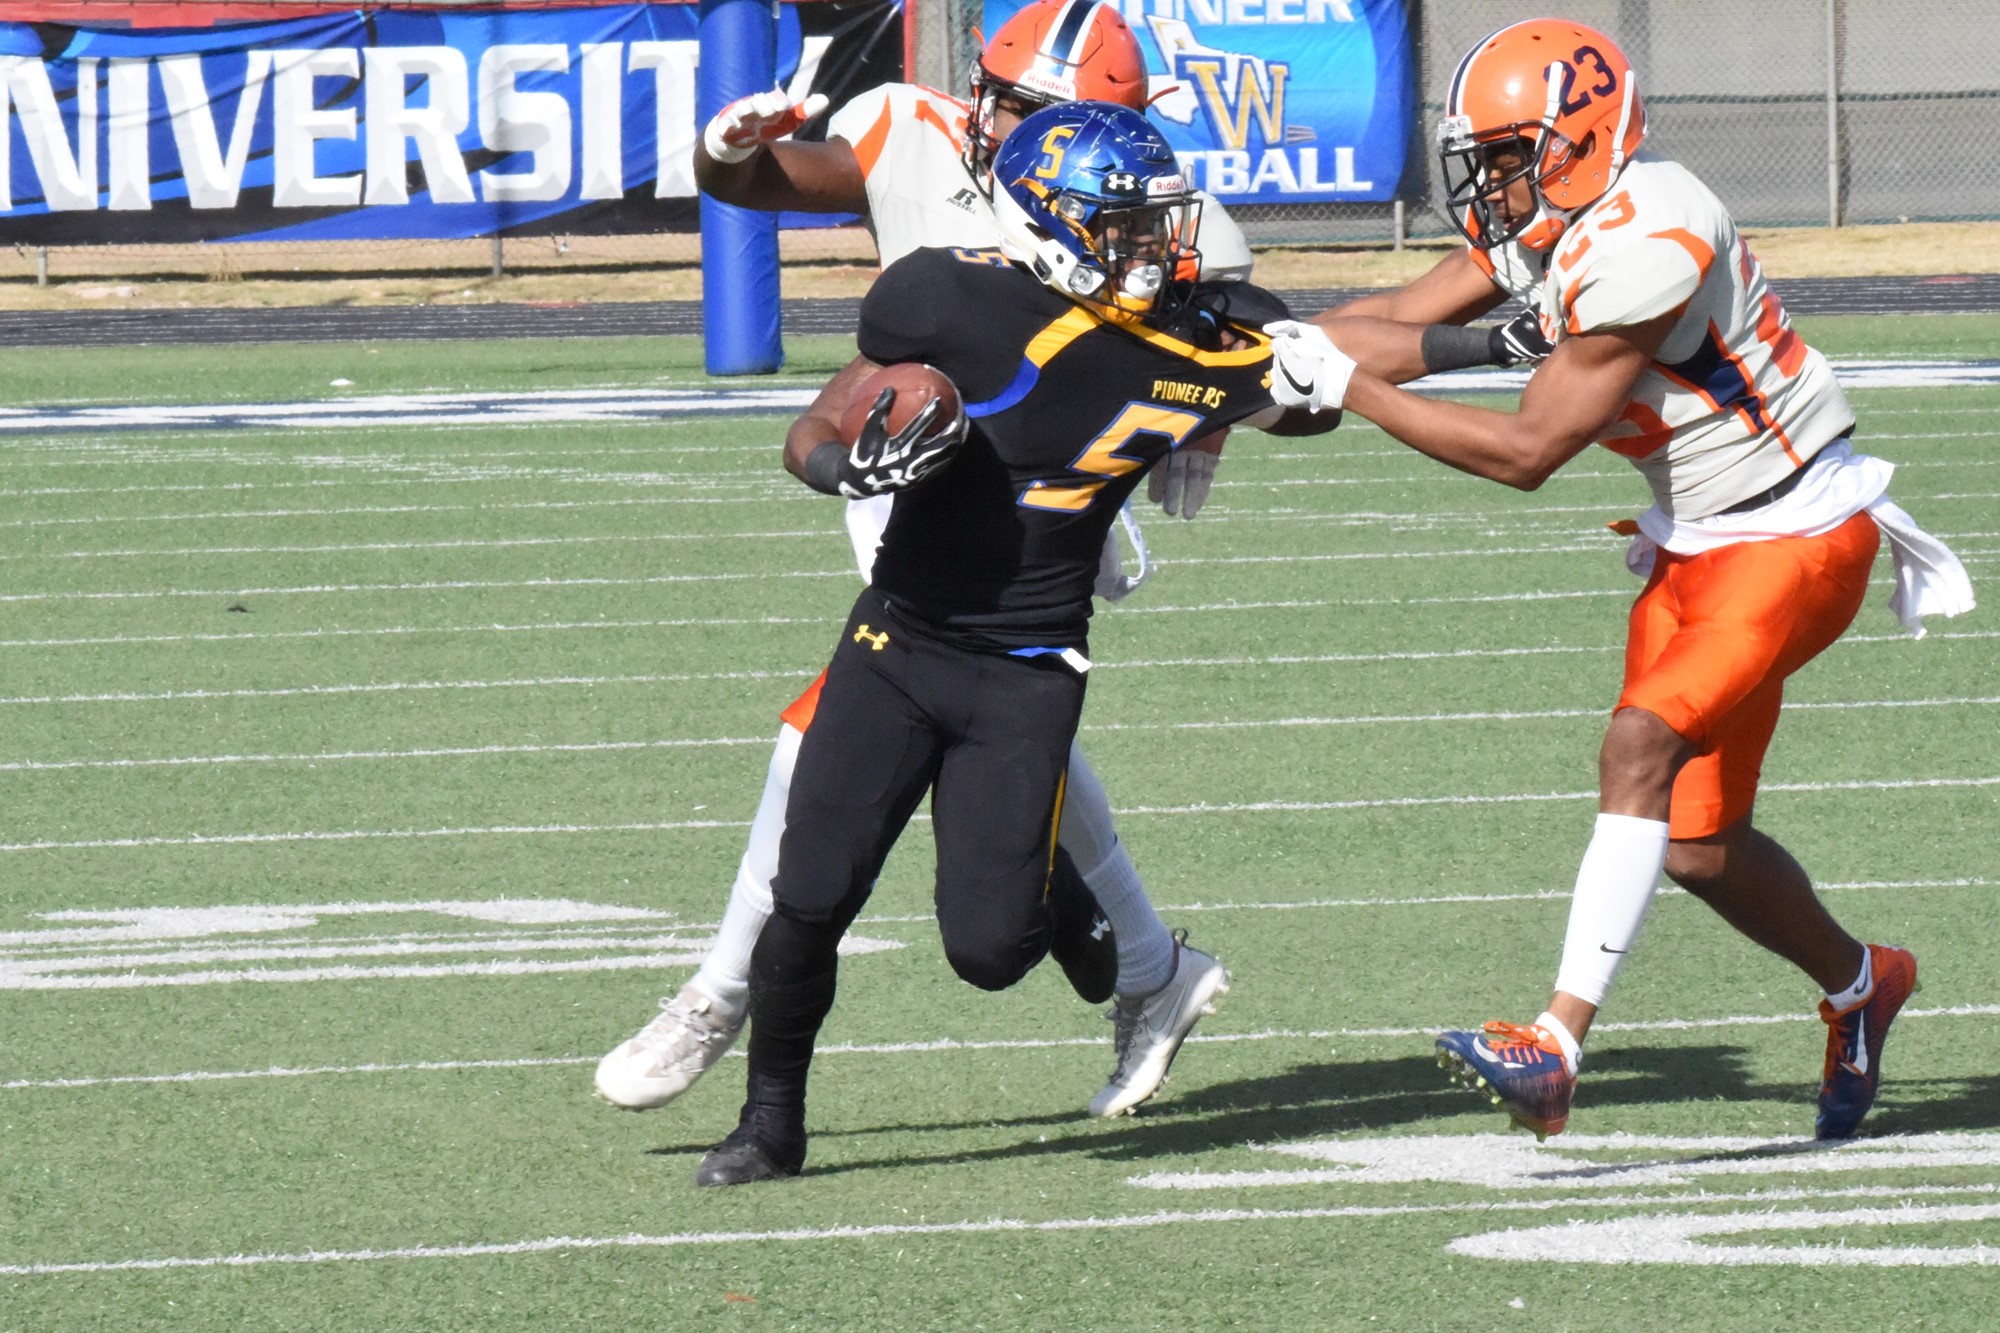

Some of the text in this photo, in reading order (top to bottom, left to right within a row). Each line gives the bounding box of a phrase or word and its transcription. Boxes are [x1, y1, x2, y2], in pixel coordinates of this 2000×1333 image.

[1174, 54, 1291, 151] W
[1544, 45, 1617, 118] 23
[1151, 380, 1226, 409] PIONEERS
[1016, 400, 1206, 514] 5
